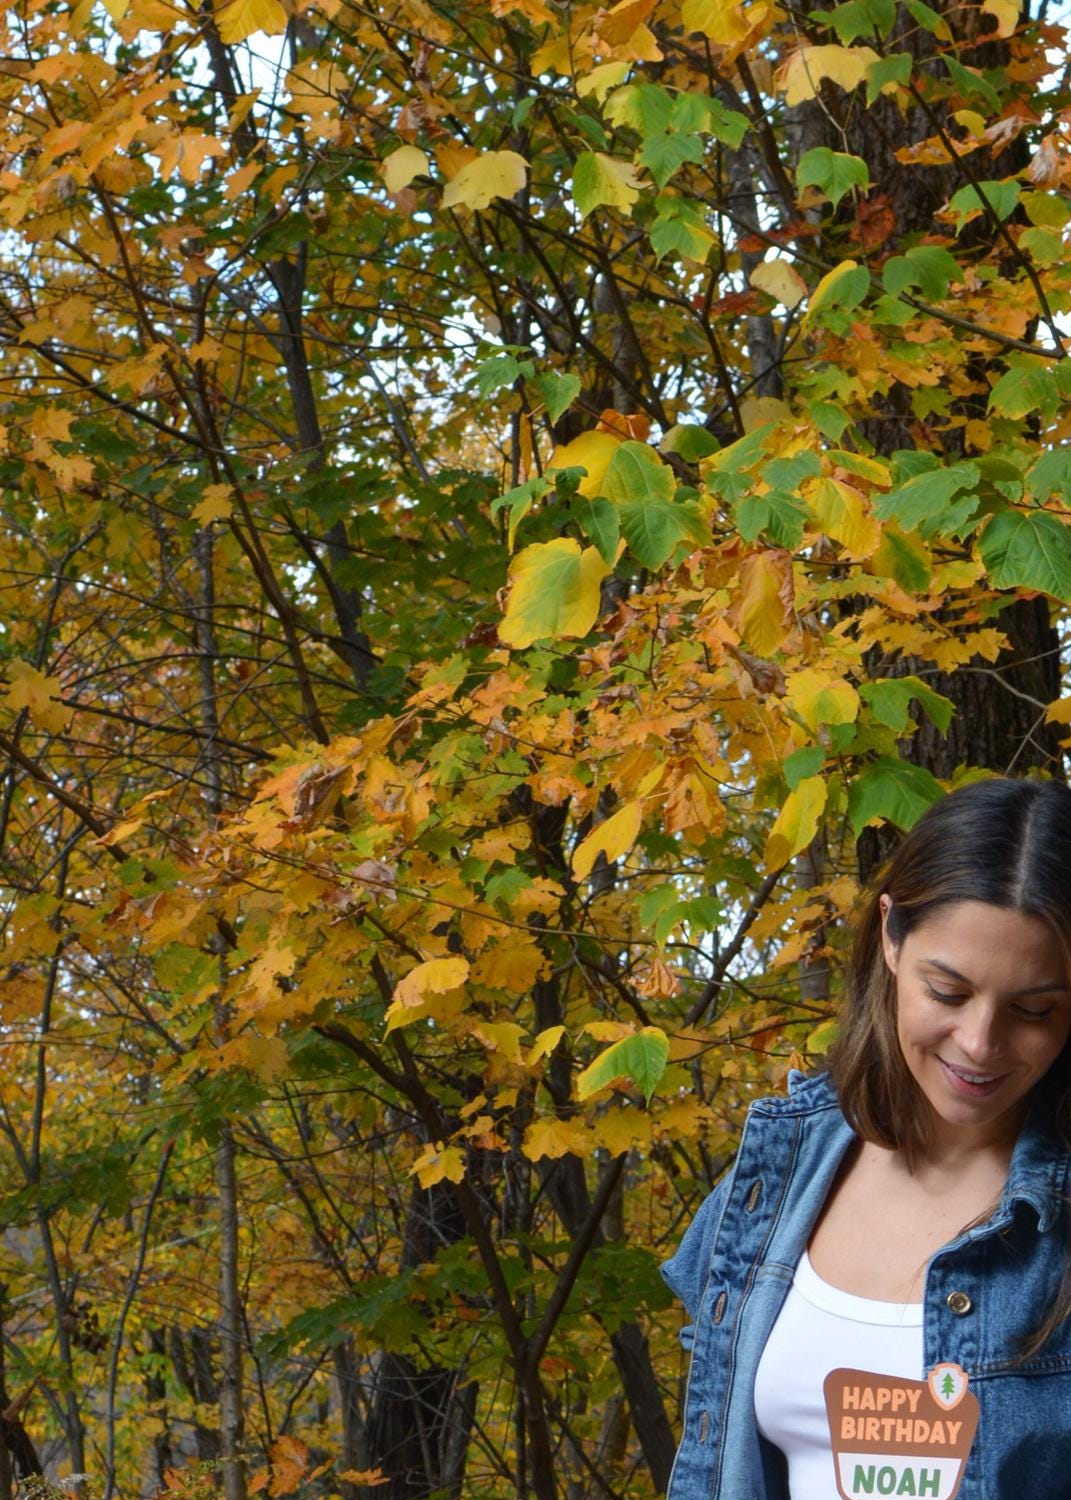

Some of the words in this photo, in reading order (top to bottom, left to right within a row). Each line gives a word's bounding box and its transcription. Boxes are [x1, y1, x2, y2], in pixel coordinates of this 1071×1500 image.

[842, 1386, 922, 1413] HAPPY
[841, 1416, 963, 1445] BIRTHDAY
[853, 1465, 941, 1497] NOAH
